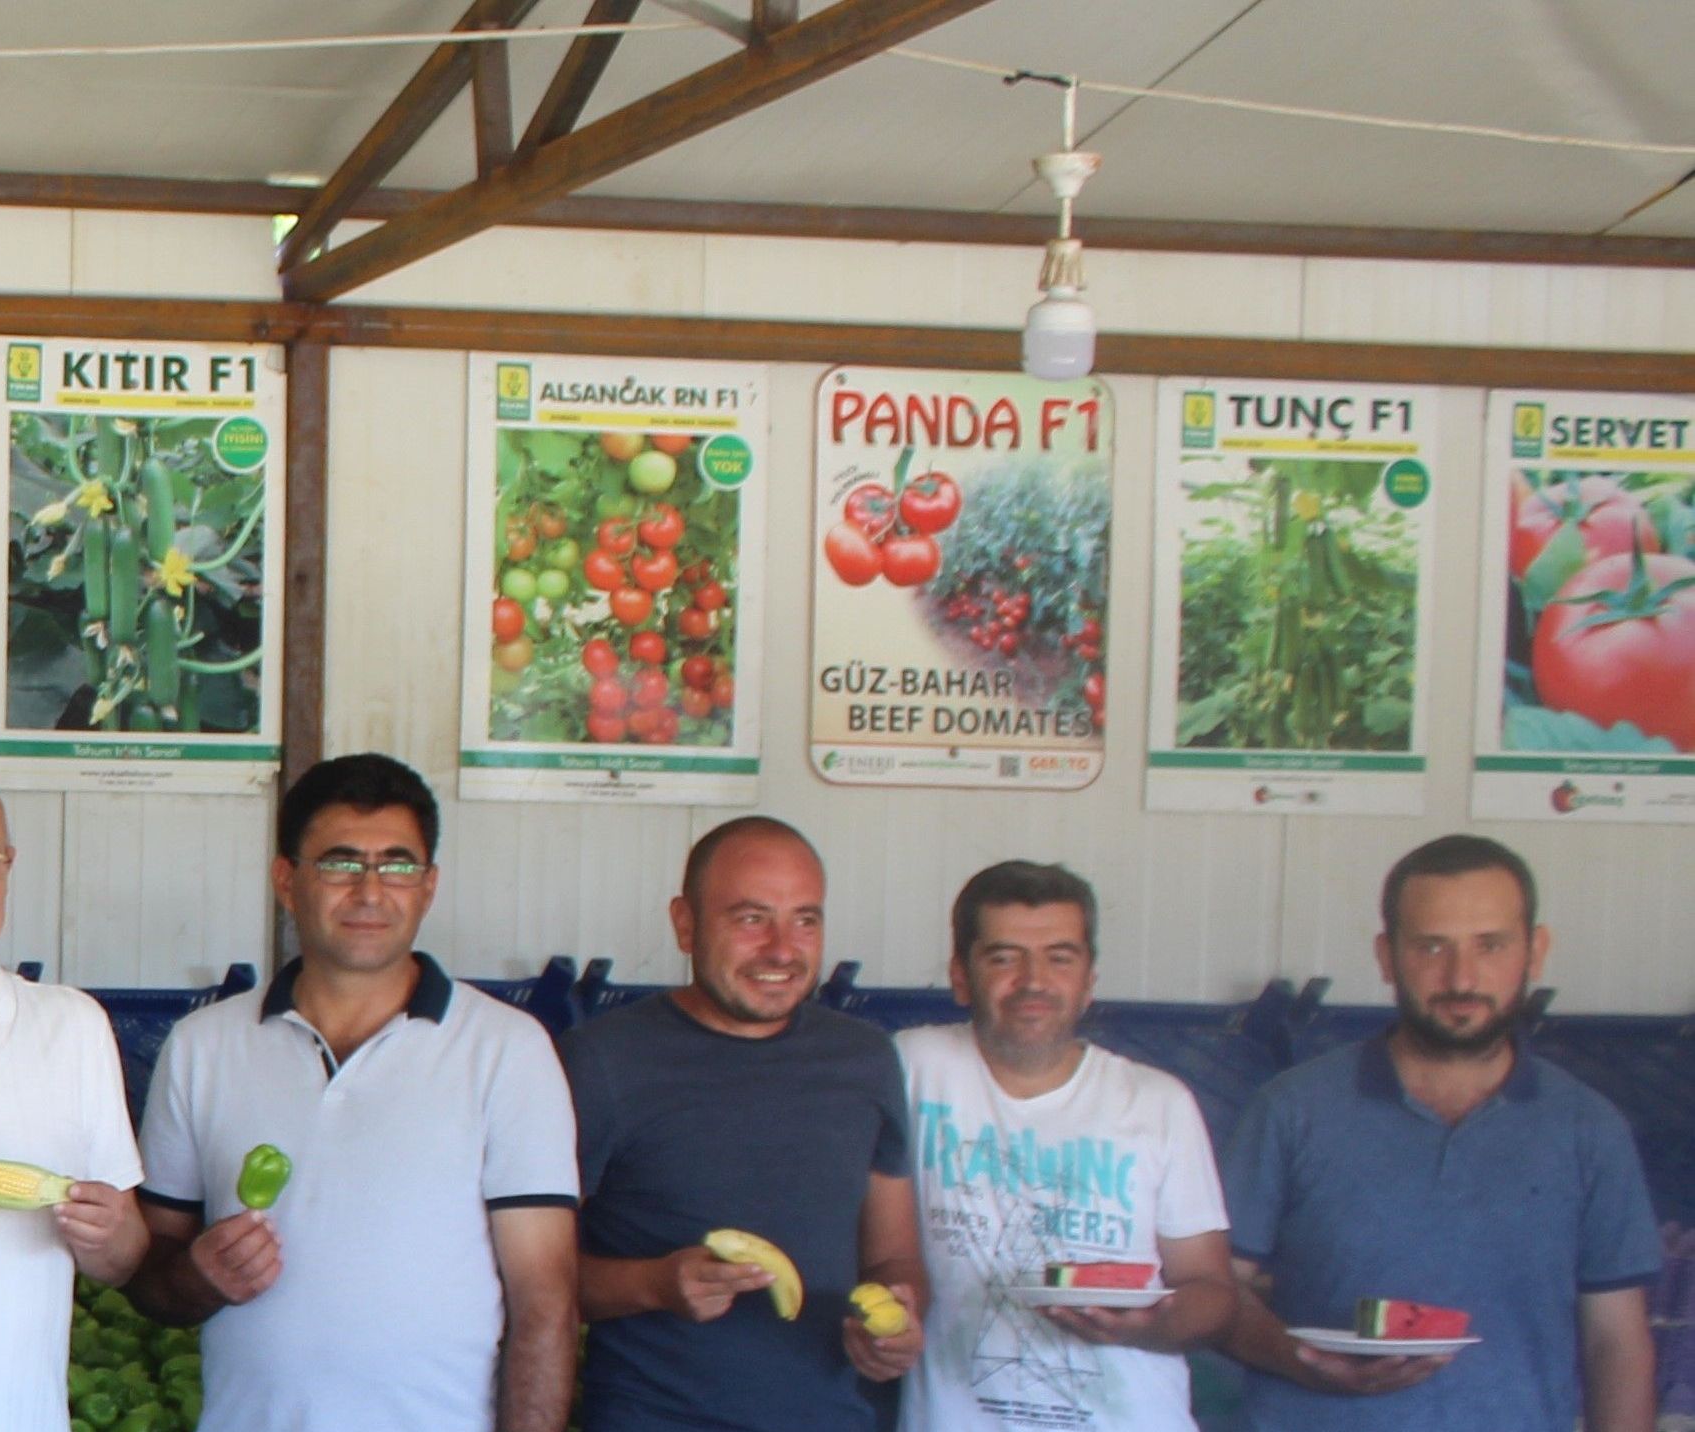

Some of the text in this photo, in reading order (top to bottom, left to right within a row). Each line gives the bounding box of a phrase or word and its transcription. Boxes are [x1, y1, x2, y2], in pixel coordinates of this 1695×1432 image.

[62, 352, 189, 392] KITIR
[210, 356, 256, 392] F1
[674, 388, 708, 407] RN
[716, 389, 739, 408] F1
[832, 391, 1099, 452] PANDA F1
[1228, 395, 1413, 440] TUNÇ F1
[1550, 415, 1690, 449] SERVET
[820, 660, 1013, 697] GÜZ-BAHAR
[849, 705, 1093, 737] BEEF DOMATES
